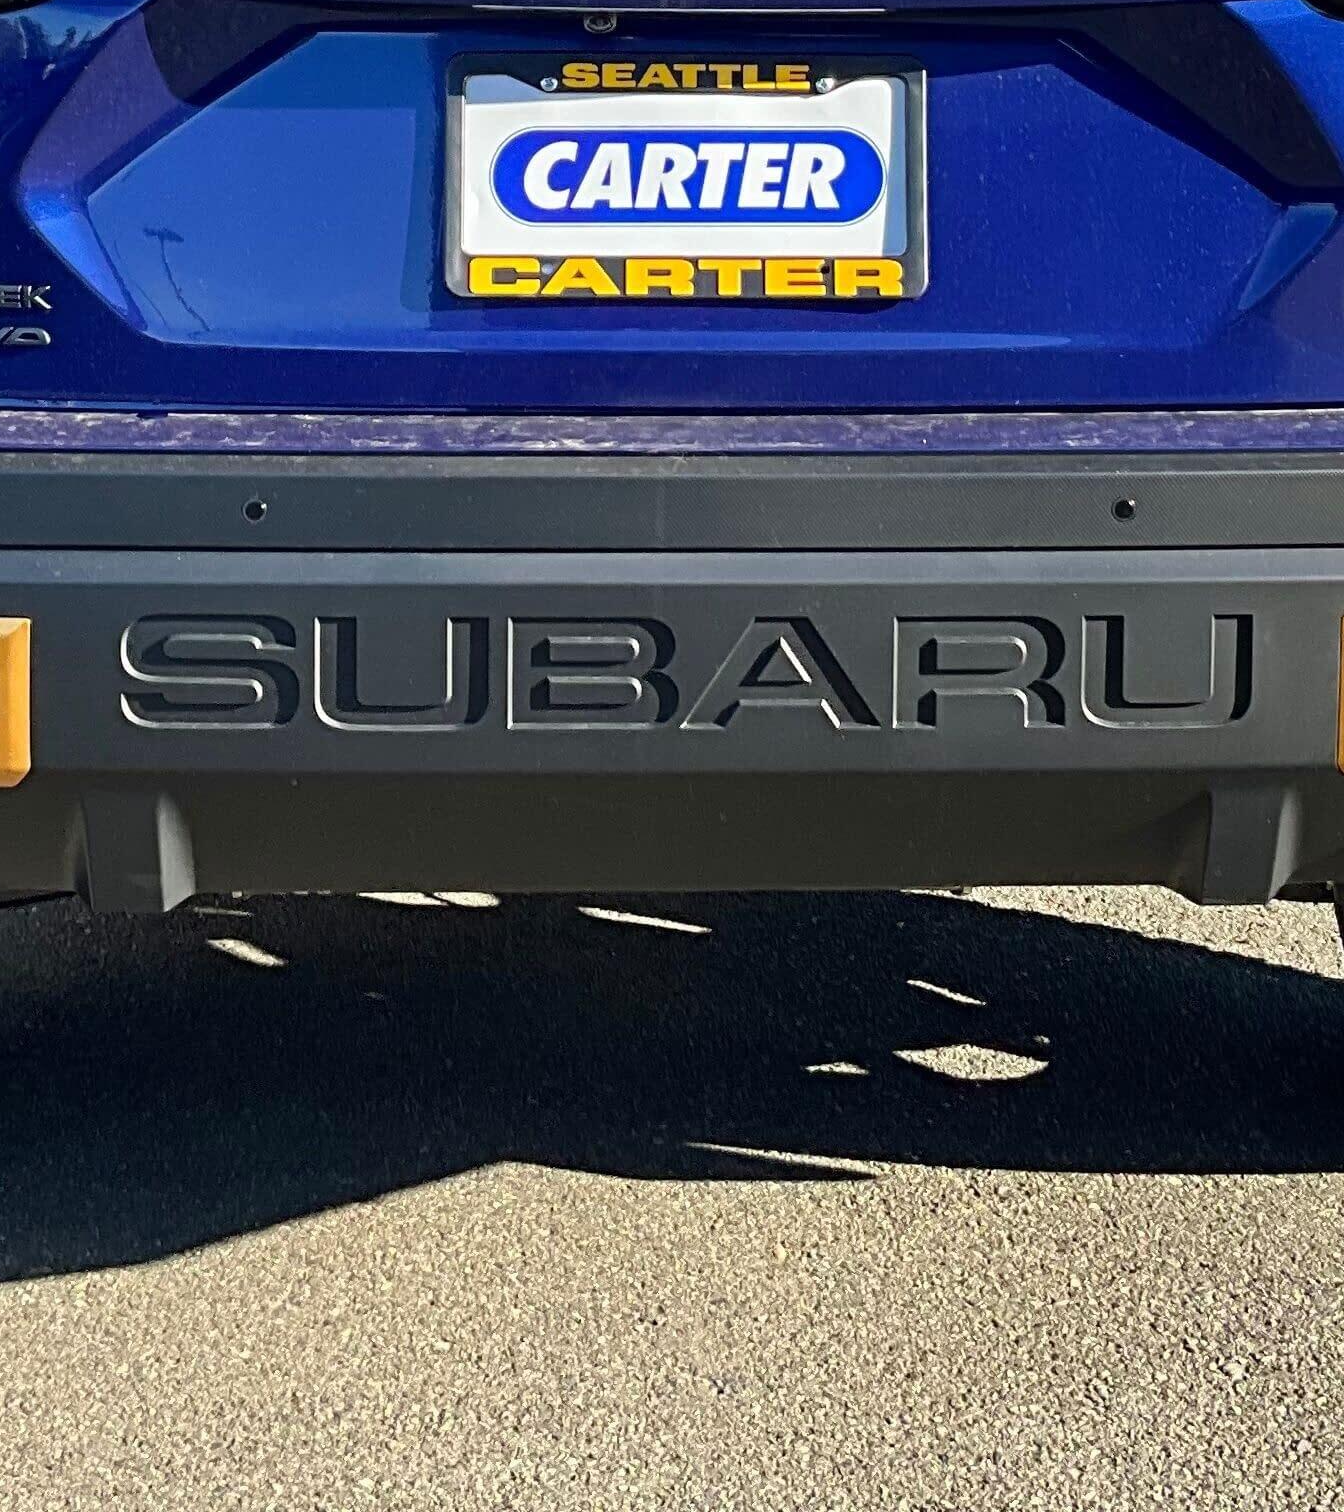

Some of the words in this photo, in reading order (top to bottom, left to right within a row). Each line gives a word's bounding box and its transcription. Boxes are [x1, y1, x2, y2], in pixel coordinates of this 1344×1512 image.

[561, 62, 811, 90] SEATTLE
[523, 140, 846, 210] CARTER
[468, 256, 905, 298] CARTER
[120, 613, 1256, 731] SUBARU
